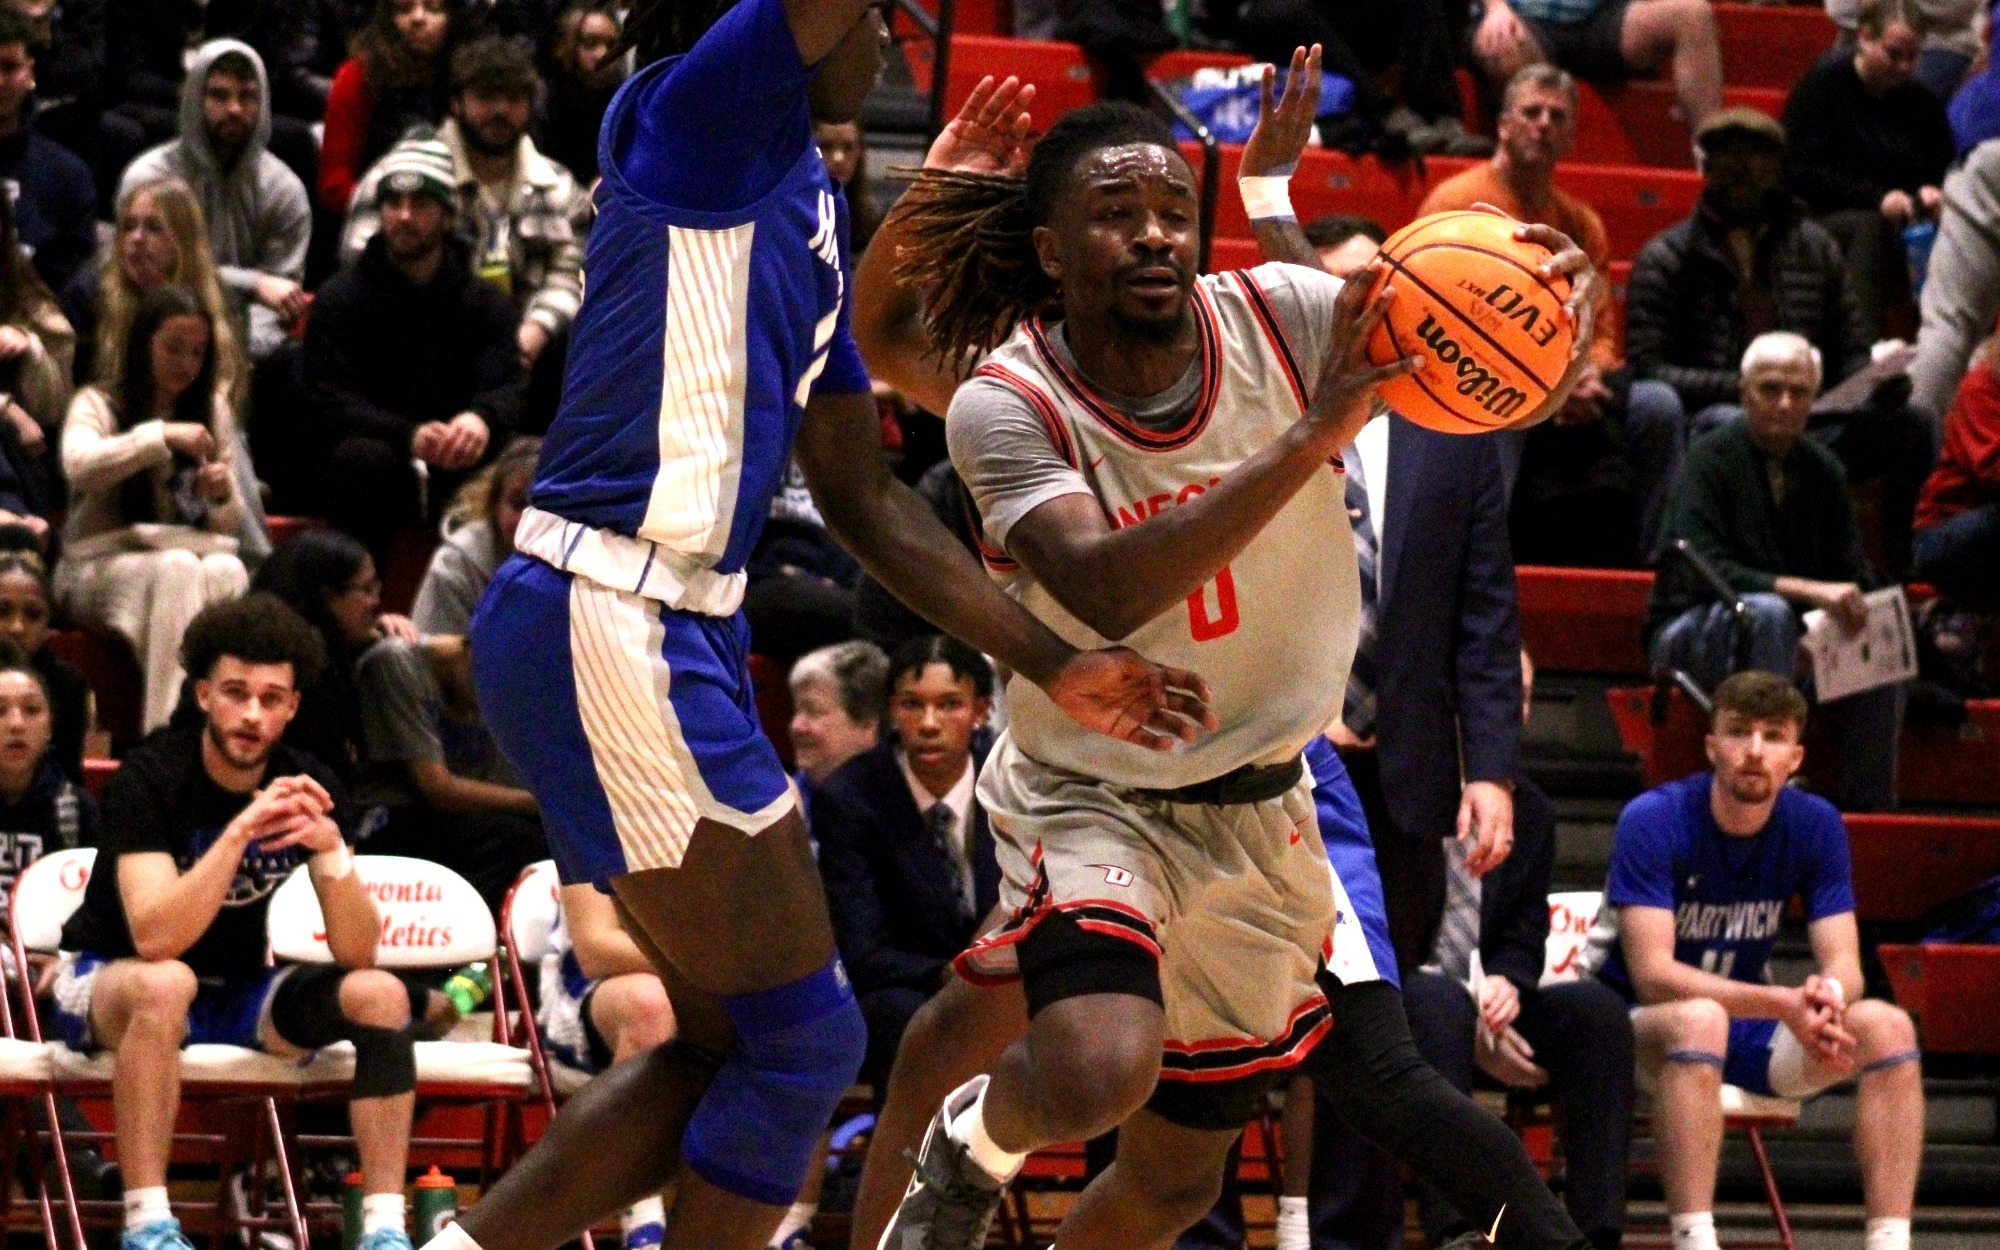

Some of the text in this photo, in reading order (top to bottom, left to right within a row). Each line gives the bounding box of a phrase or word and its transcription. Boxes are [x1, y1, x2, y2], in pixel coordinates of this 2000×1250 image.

[1456, 278, 1558, 347] EVO NXT
[1416, 313, 1527, 418] Wilson
[364, 880, 442, 902] eonta
[1548, 903, 1598, 934] On
[1676, 900, 1783, 940] HARTWICK
